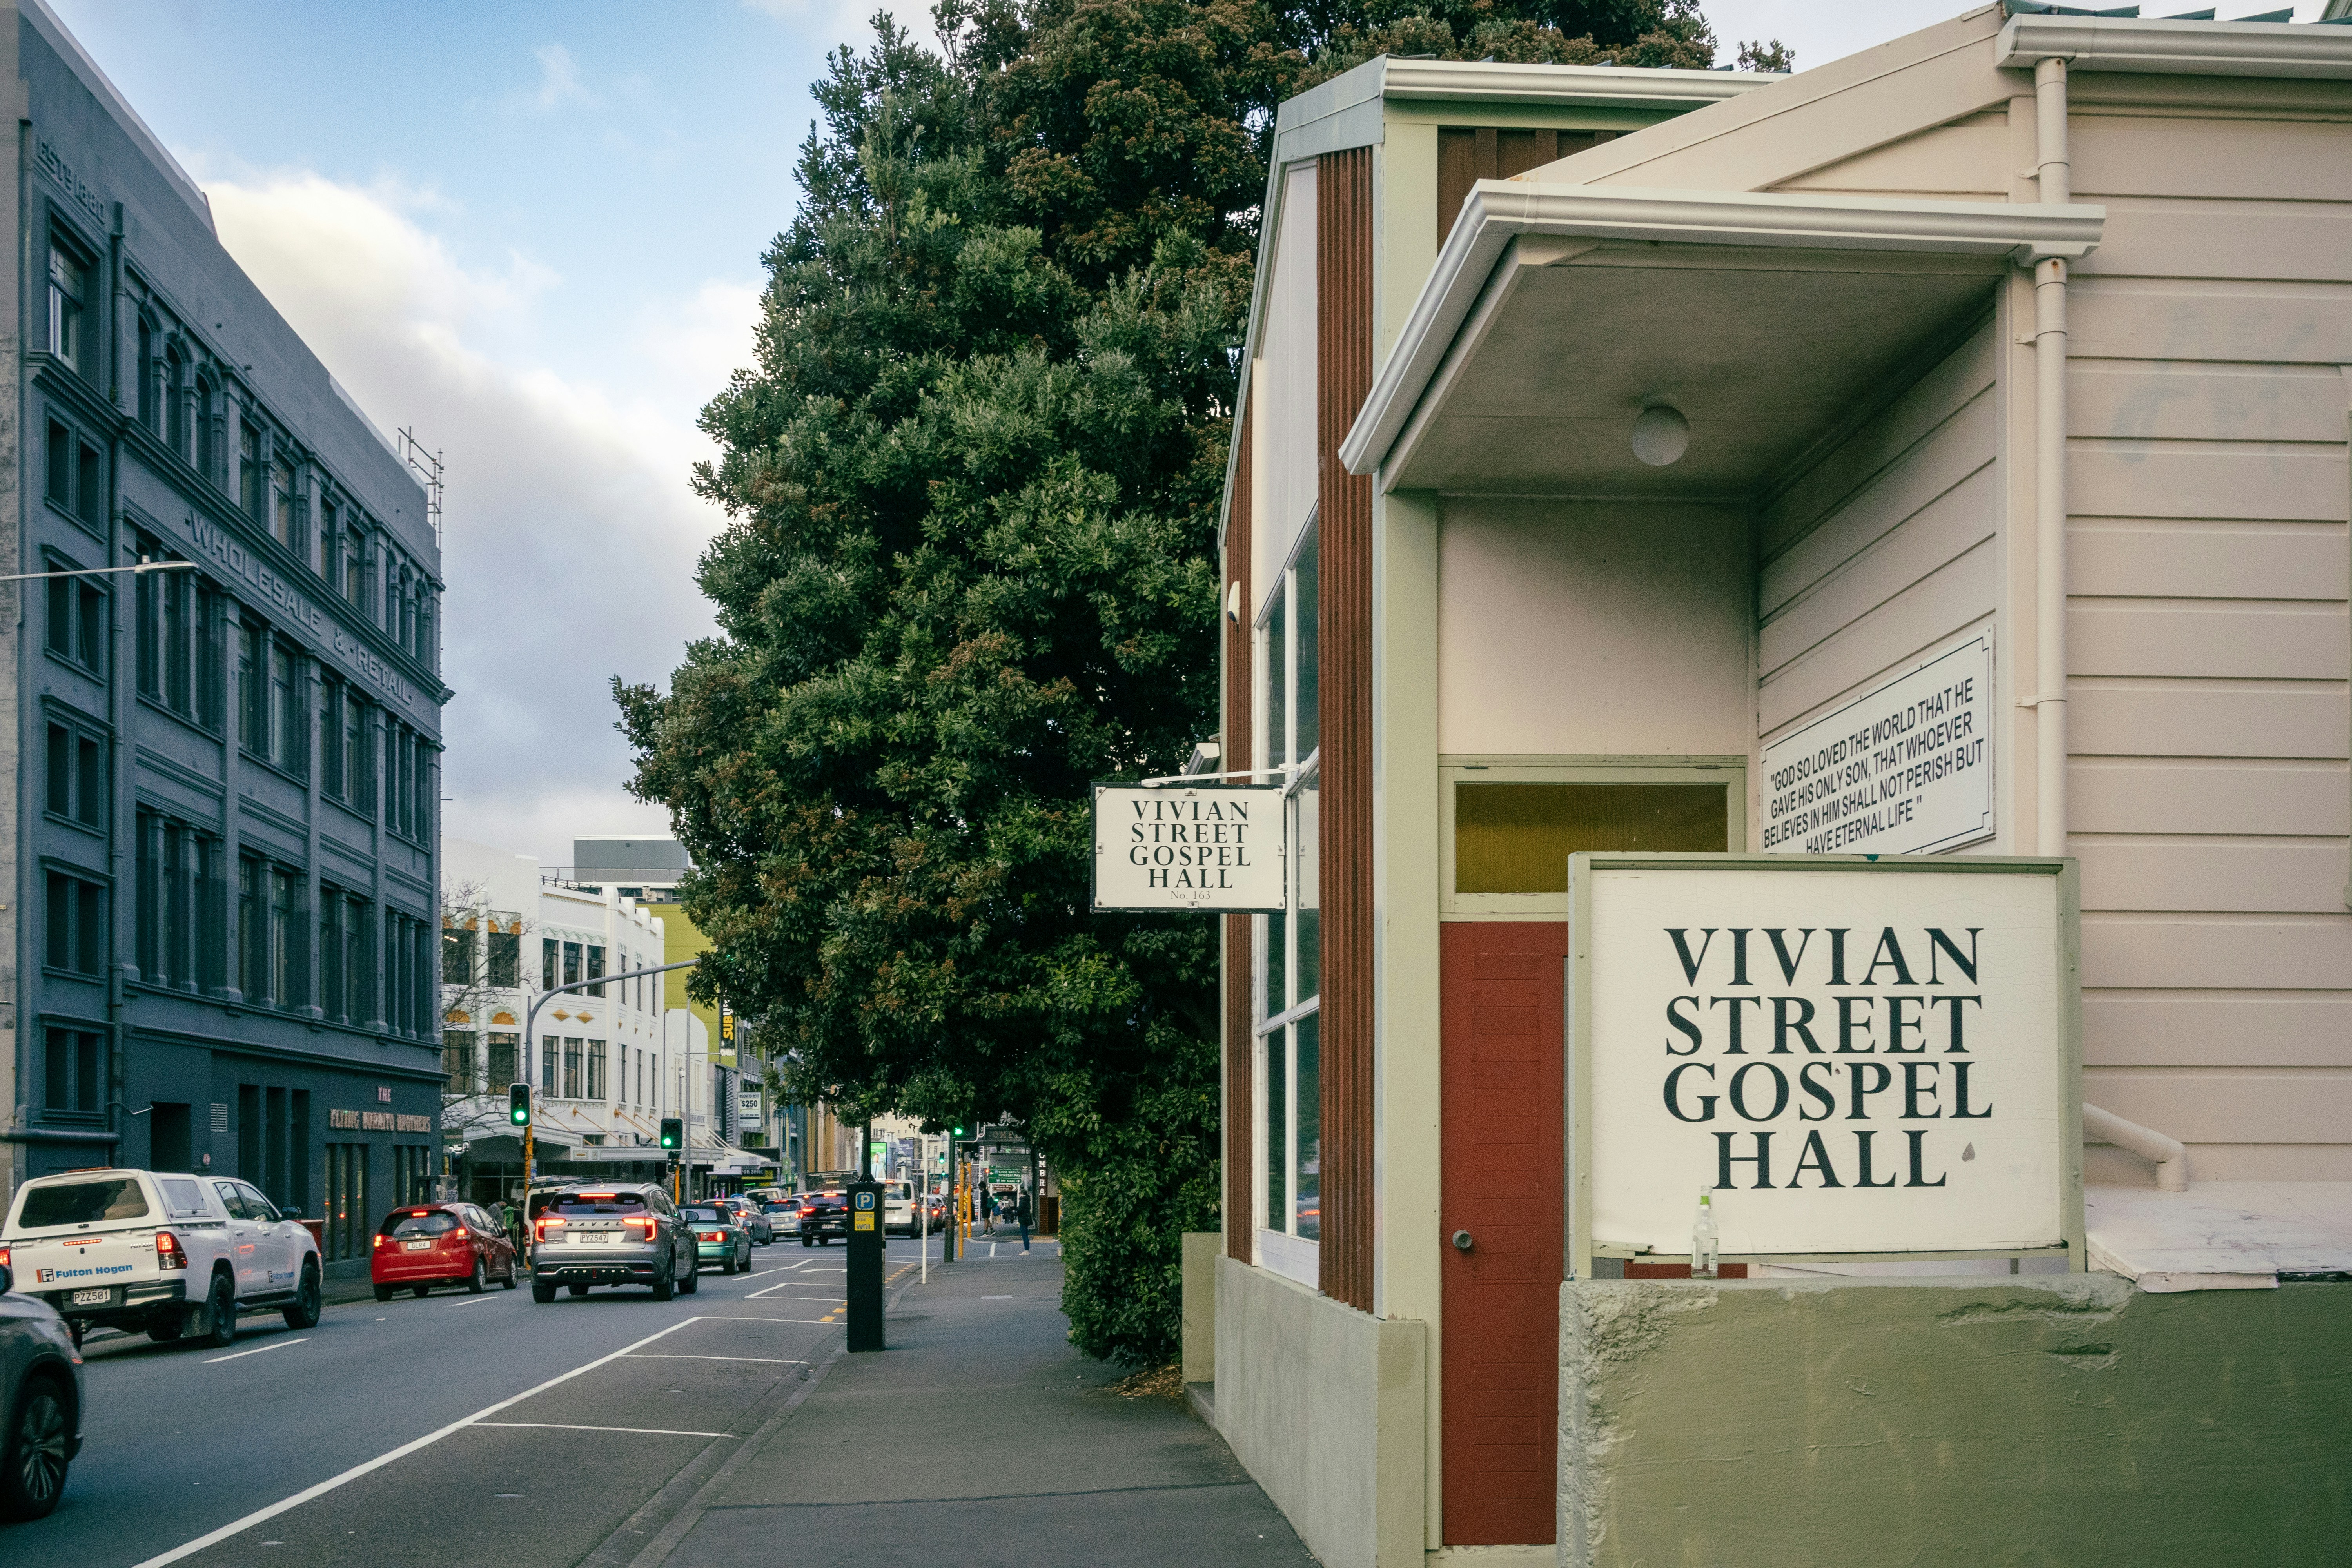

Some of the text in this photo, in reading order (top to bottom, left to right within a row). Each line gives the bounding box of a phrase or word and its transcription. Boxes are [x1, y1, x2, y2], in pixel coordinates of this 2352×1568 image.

[190, 510, 411, 706] WHOLESALE & RETAIL
[1797, 757, 1811, 782] SO
[1812, 739, 1847, 775] LOVED
[1848, 727, 1870, 757] THE
[1871, 706, 1916, 746] WORLD
[1918, 687, 1952, 724] THAT
[1955, 677, 1973, 708] HE
[1764, 737, 1984, 849] BELIEVES IN HIM SHALL NOT PERISH BUT
[1771, 711, 1973, 820] GAVE HIS ONLY SON, THAT WHOEVER
[1131, 800, 1250, 820] VIVIAN
[1132, 823, 1249, 843] STREET
[1806, 829, 1833, 855] HAVE
[1835, 811, 1886, 848] ETERNAL
[1888, 798, 1913, 829] LIFE
[1129, 846, 1251, 866] GOSPEL
[1147, 868, 1233, 889] HALL
[1170, 891, 1210, 900] No. 163
[1663, 926, 1984, 987] VIVIAN
[1666, 995, 1983, 1056] STREET
[378, 1087, 391, 1102] THE
[1663, 1061, 1993, 1123] GOSPEL
[1711, 1129, 1947, 1189] HALL
[56, 1265, 133, 1278] Fulton Hogan
[74, 1291, 109, 1302] PZZ501
